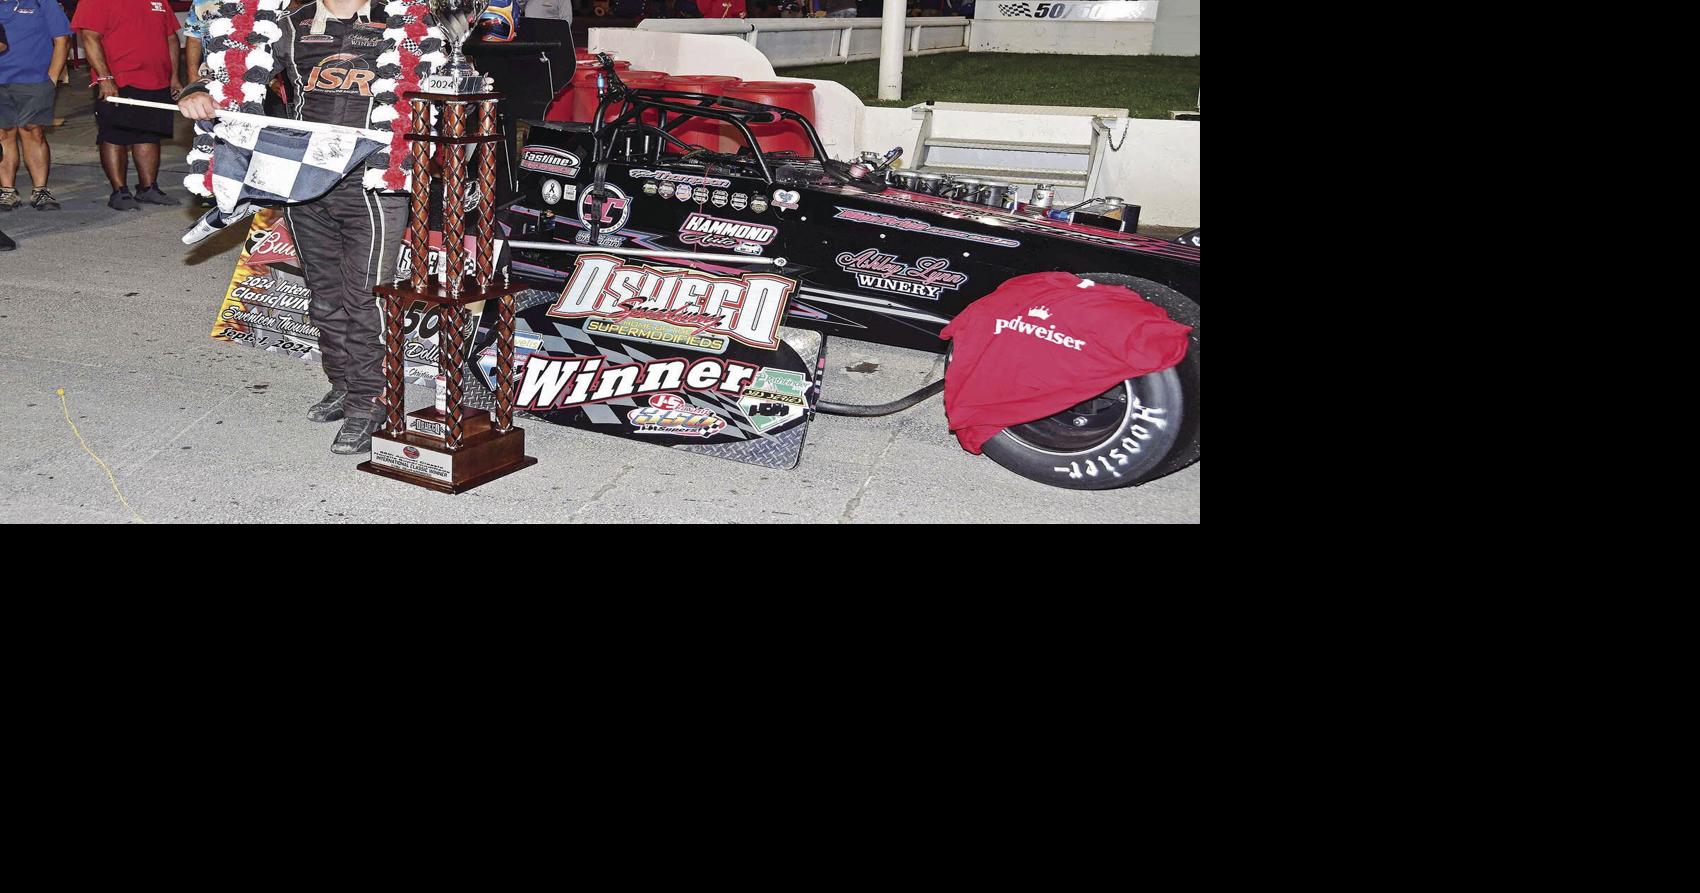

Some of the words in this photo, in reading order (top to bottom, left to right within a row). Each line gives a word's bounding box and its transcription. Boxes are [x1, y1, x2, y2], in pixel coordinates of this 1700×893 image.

[303, 66, 374, 97] JSR
[430, 80, 454, 89] 2024
[683, 233, 736, 246] Auto
[685, 216, 773, 242] HAMMOND
[838, 250, 902, 278] Ashley
[906, 258, 963, 285] Lynn
[241, 276, 274, 289] 2024
[858, 274, 941, 298] WINERY
[231, 286, 276, 304] Classic
[280, 294, 312, 311] WIN
[550, 255, 794, 348] OSWEGO
[222, 306, 276, 327] Seventeen
[219, 327, 254, 342] Sept.
[272, 339, 313, 353] 2024
[514, 338, 539, 348] velis
[588, 321, 723, 350] SUPERMODIFIEDS
[515, 355, 756, 408] Winner
